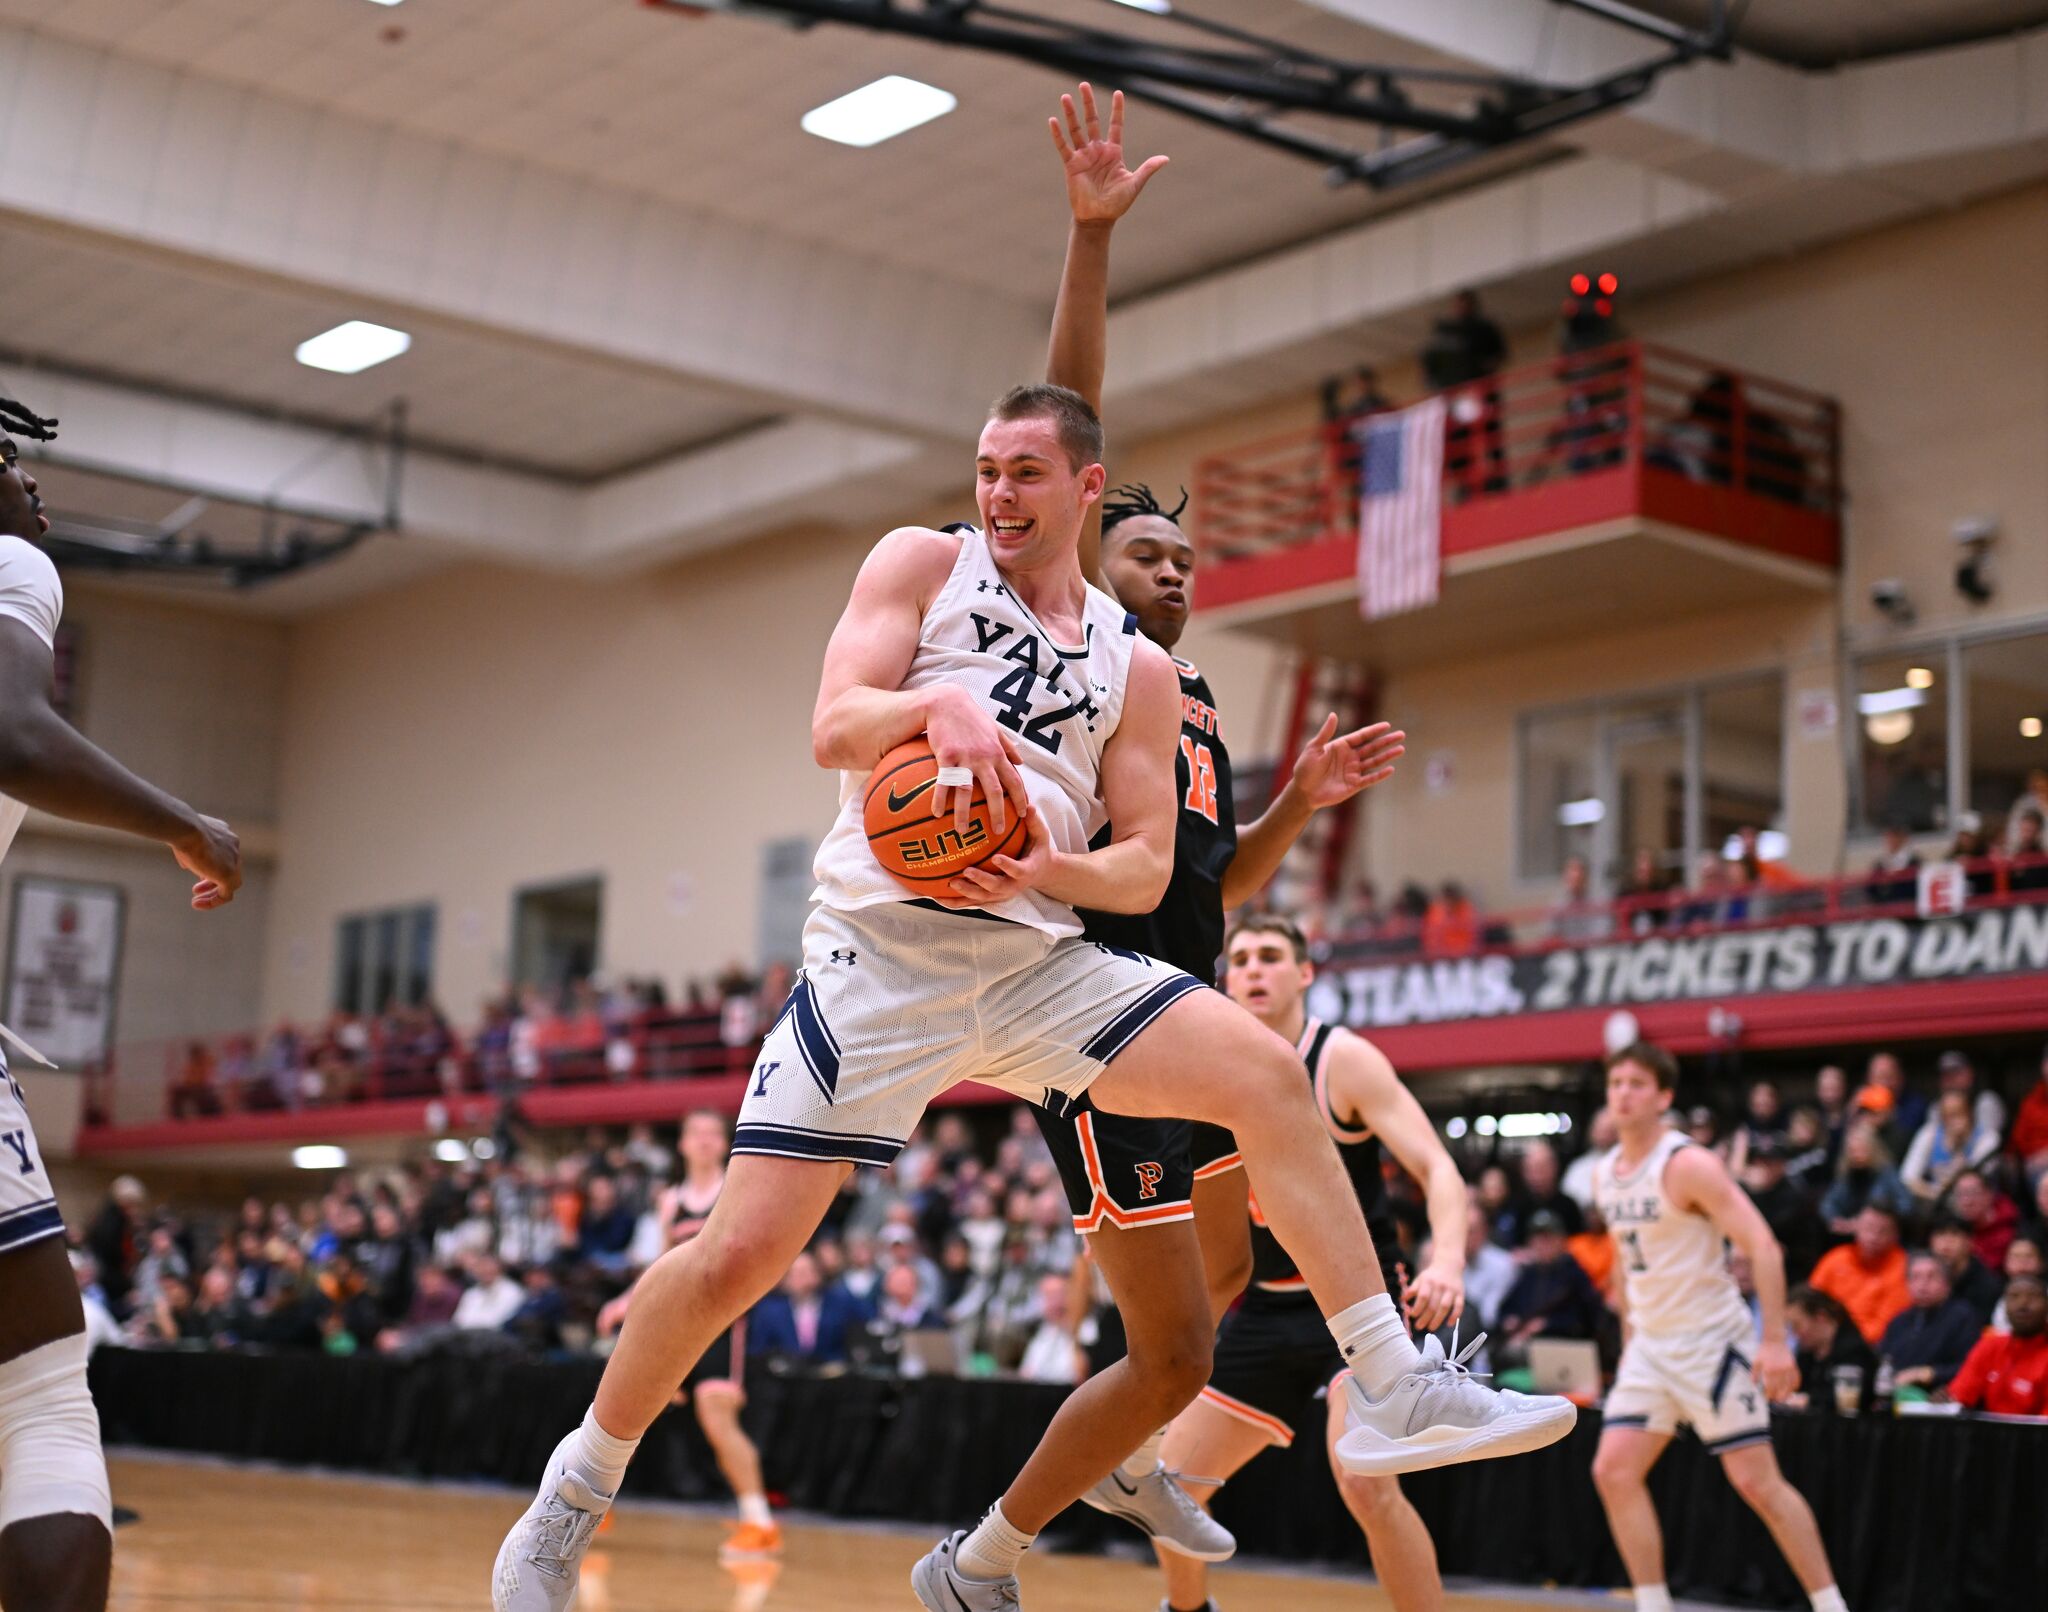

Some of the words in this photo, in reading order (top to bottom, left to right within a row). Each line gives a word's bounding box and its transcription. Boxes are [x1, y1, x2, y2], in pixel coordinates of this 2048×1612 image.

[990, 667, 1079, 755] 42
[1180, 733, 1219, 827] 12
[898, 817, 988, 864] ELITE
[1534, 949, 1579, 1011] 2
[1582, 924, 1819, 1006] TICKETS
[1826, 917, 1908, 986] TO
[752, 1061, 782, 1099] Y
[1, 1128, 36, 1176] Y
[1134, 1161, 1164, 1200] P
